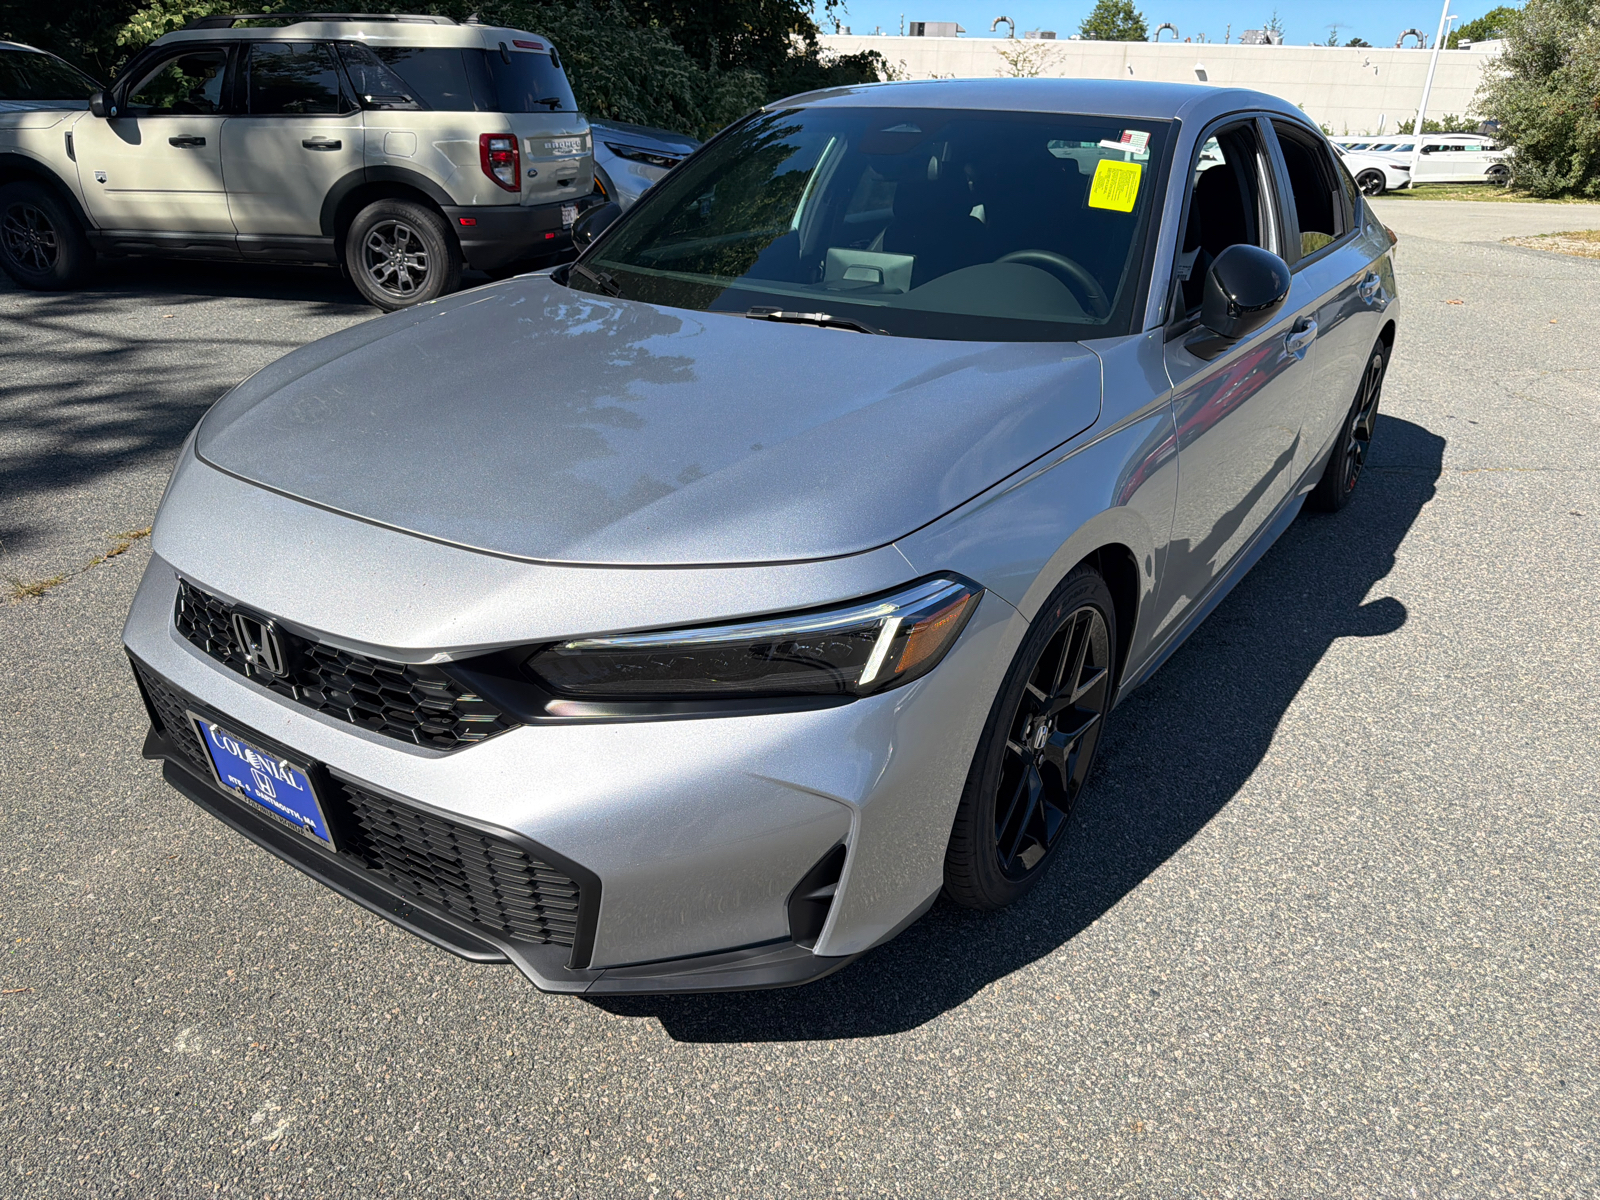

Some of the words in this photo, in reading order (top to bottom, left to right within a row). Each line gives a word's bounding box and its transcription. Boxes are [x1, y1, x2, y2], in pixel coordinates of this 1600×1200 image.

[544, 141, 581, 149] BRONCO
[210, 727, 304, 792] COLONIAL
[254, 789, 303, 822] DARTMOUTH,
[303, 815, 317, 829] MA
